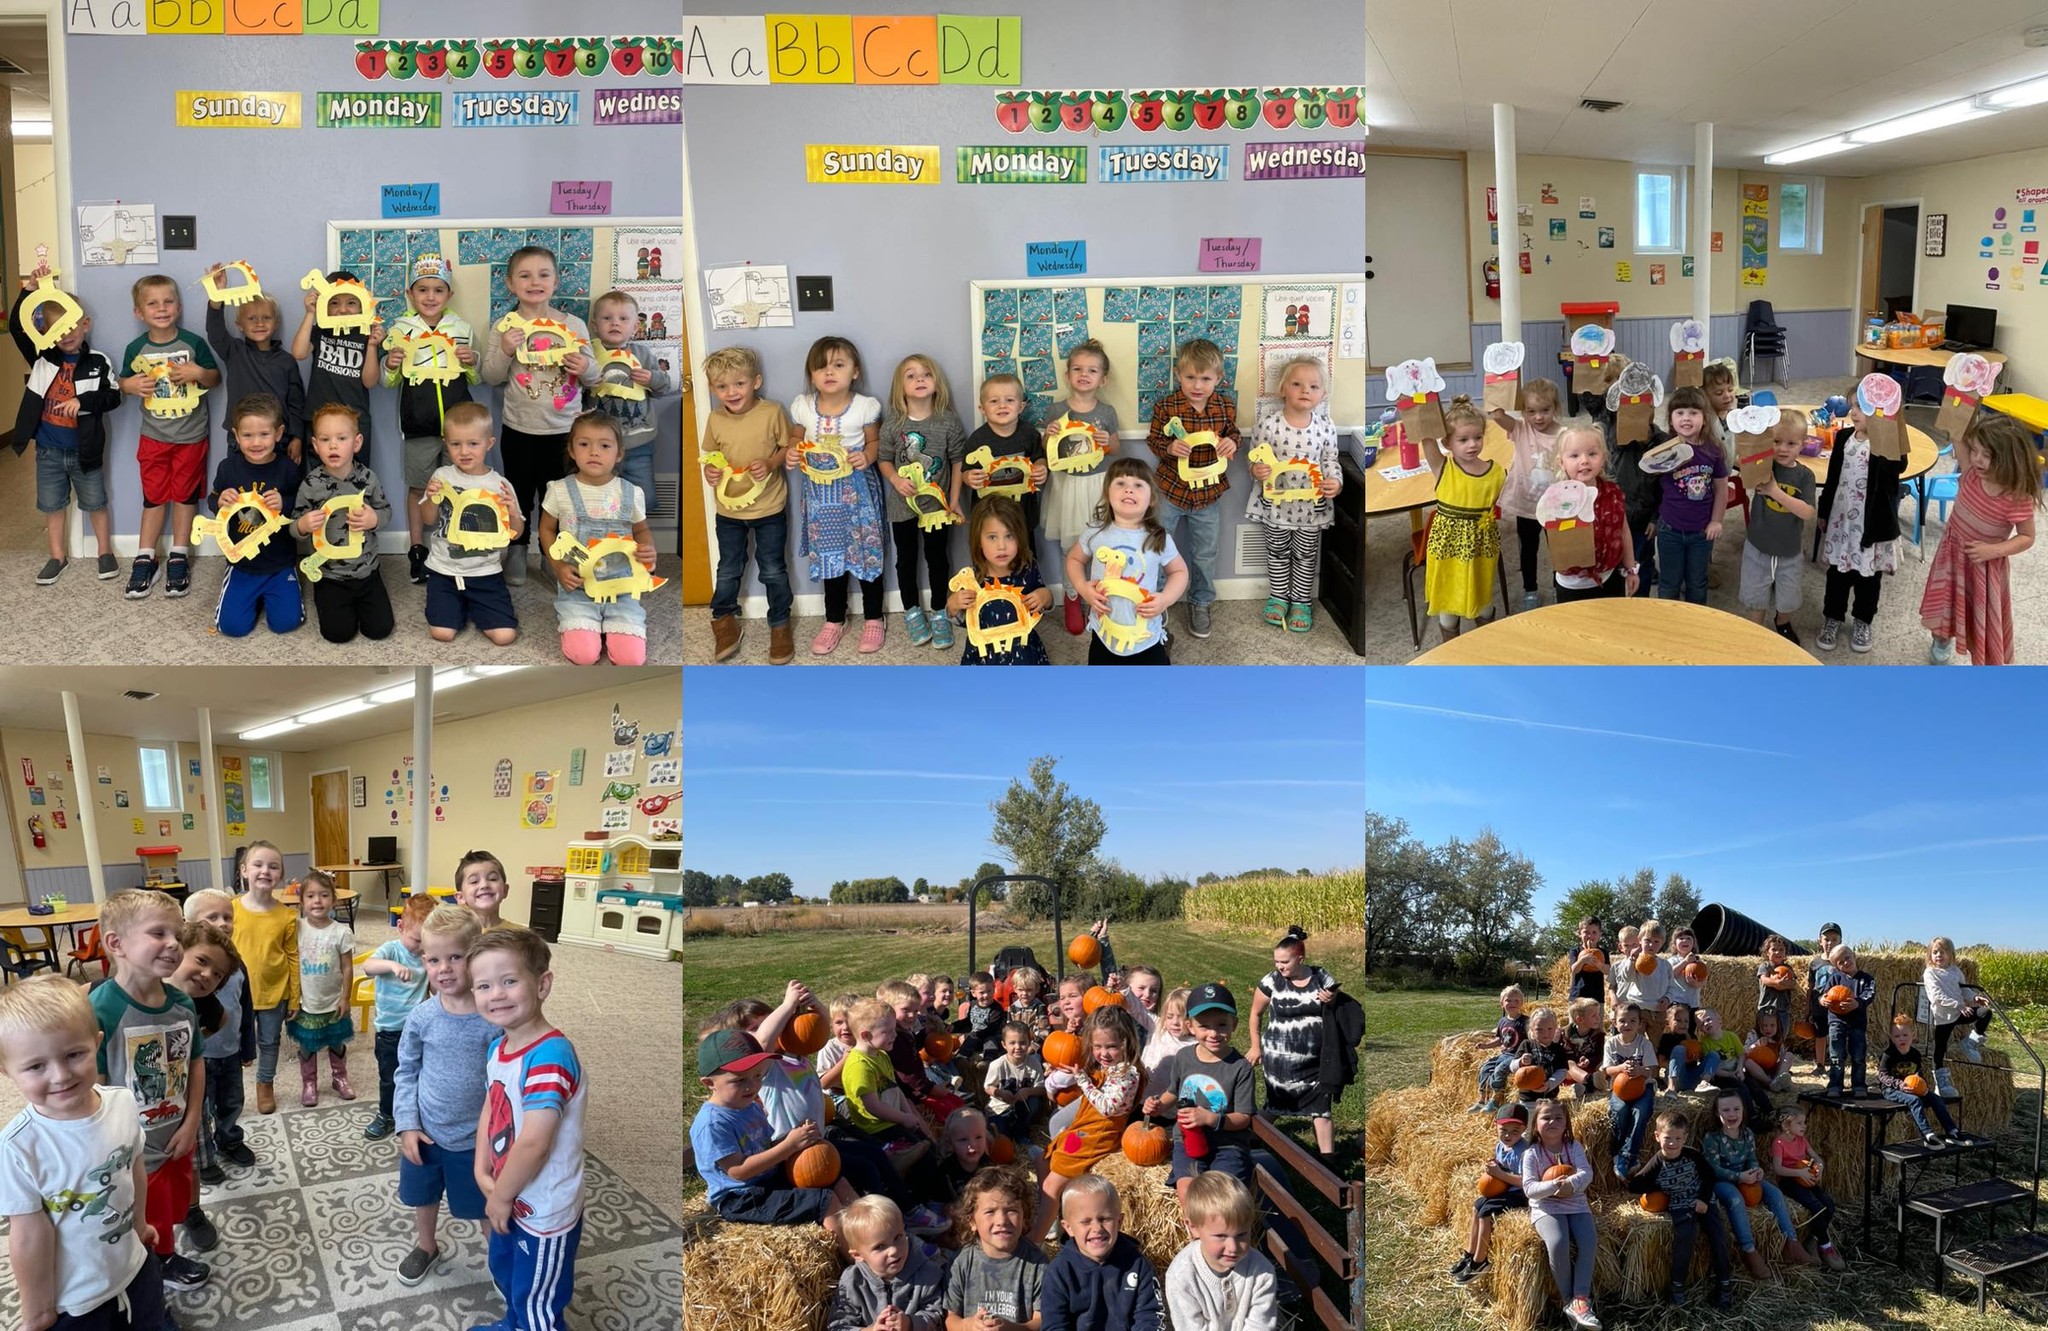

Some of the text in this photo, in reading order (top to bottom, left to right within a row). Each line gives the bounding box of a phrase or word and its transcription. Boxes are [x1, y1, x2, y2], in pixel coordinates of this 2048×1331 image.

[368, 51, 669, 72] 1 2 3 4 5 6 7 8 9 10
[191, 94, 287, 125] Sunday
[328, 96, 430, 125] Monday
[462, 94, 571, 124] Tuesday
[1009, 101, 1351, 125] 1 2 3 4 5 6 7 8 9 10 11
[822, 149, 924, 180] Sunday
[969, 150, 1075, 179] Monday
[1109, 149, 1220, 178] Tuesday
[391, 201, 437, 214] Wednesday
[565, 199, 607, 213] Thursday
[1037, 260, 1083, 272] Wednesday
[1214, 256, 1256, 270] Thursday
[318, 340, 363, 369] BAD
[317, 359, 361, 378] DECISIONS
[984, 1290, 1014, 1303] I'M YOUR
